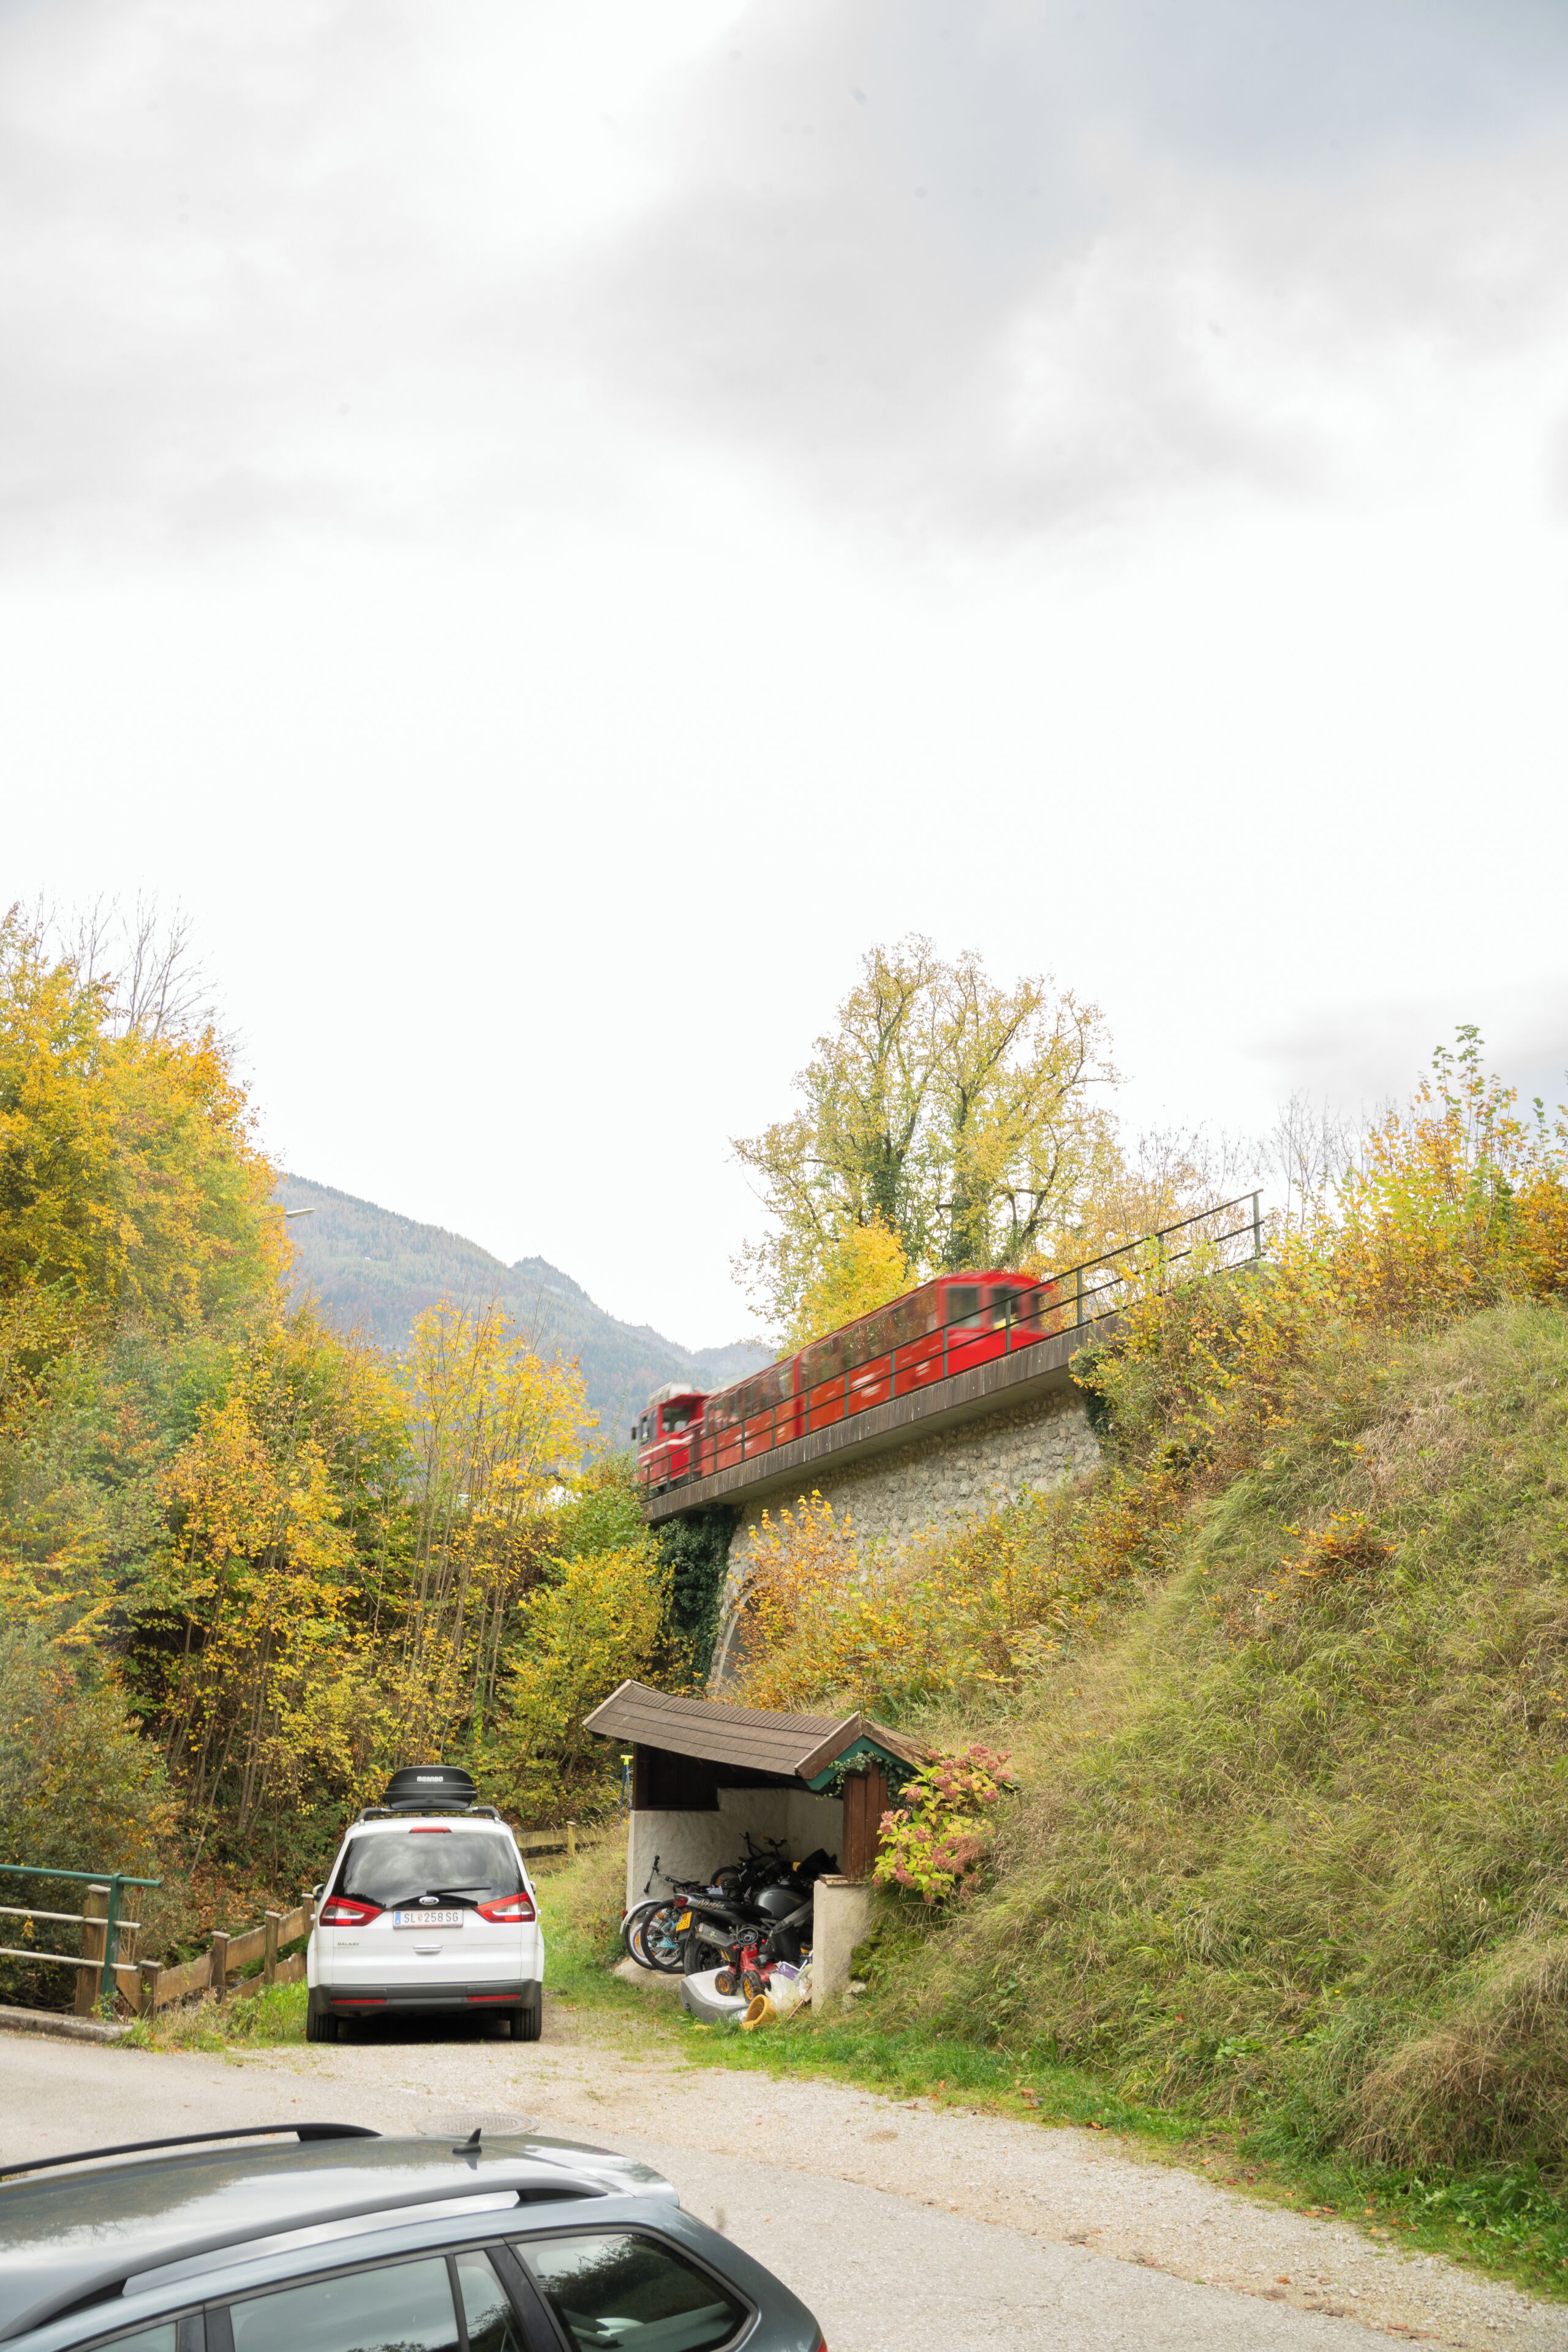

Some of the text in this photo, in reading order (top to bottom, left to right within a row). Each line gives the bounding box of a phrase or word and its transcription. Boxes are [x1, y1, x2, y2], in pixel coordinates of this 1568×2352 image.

[697, 1899, 726, 1910] Ninja
[404, 1912, 458, 1923] SL 258 SG
